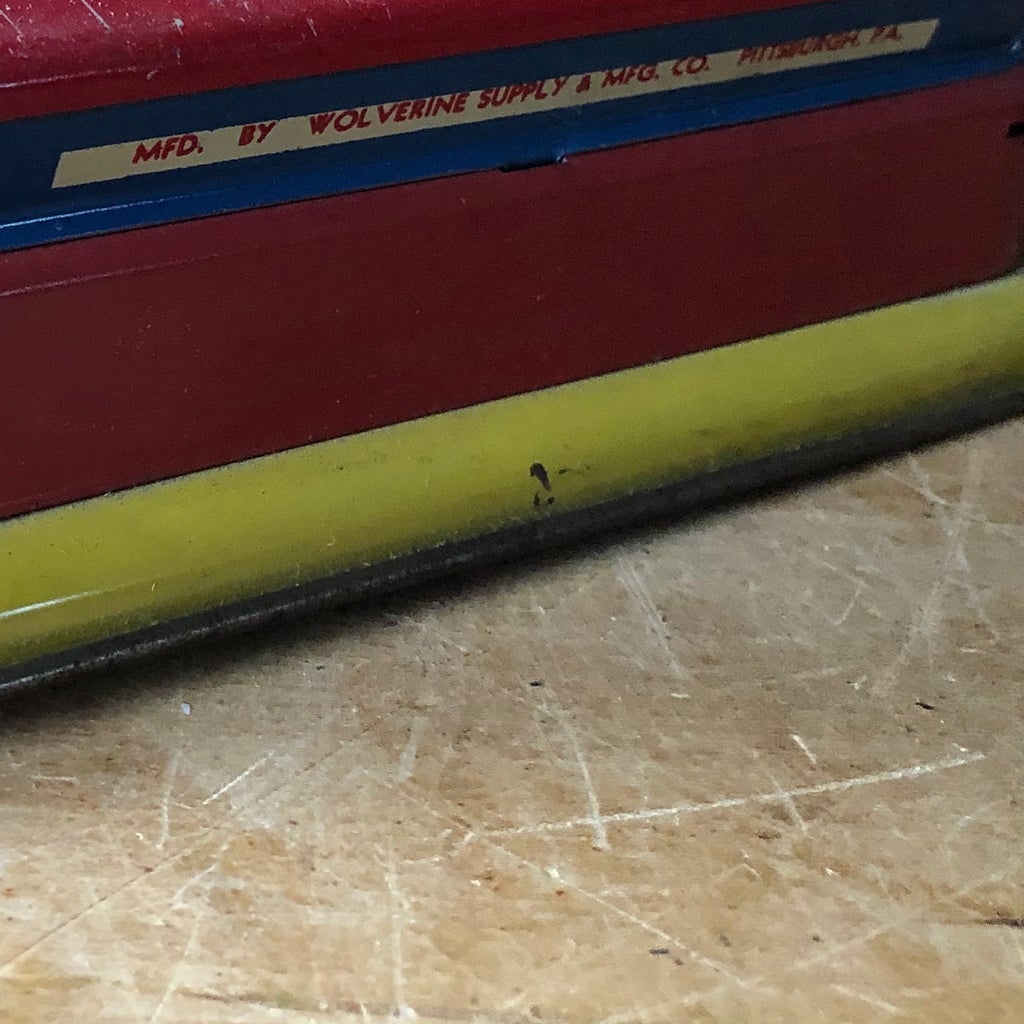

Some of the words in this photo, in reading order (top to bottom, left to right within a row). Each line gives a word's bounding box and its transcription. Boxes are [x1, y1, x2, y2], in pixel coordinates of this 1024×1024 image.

[132, 132, 204, 165] MFD.
[238, 121, 277, 147] BY
[308, 91, 471, 136] WOLVERINE
[477, 75, 571, 109] SUPPLY
[576, 73, 592, 94] &
[601, 62, 660, 89] MFG.
[671, 54, 710, 77] CO.
